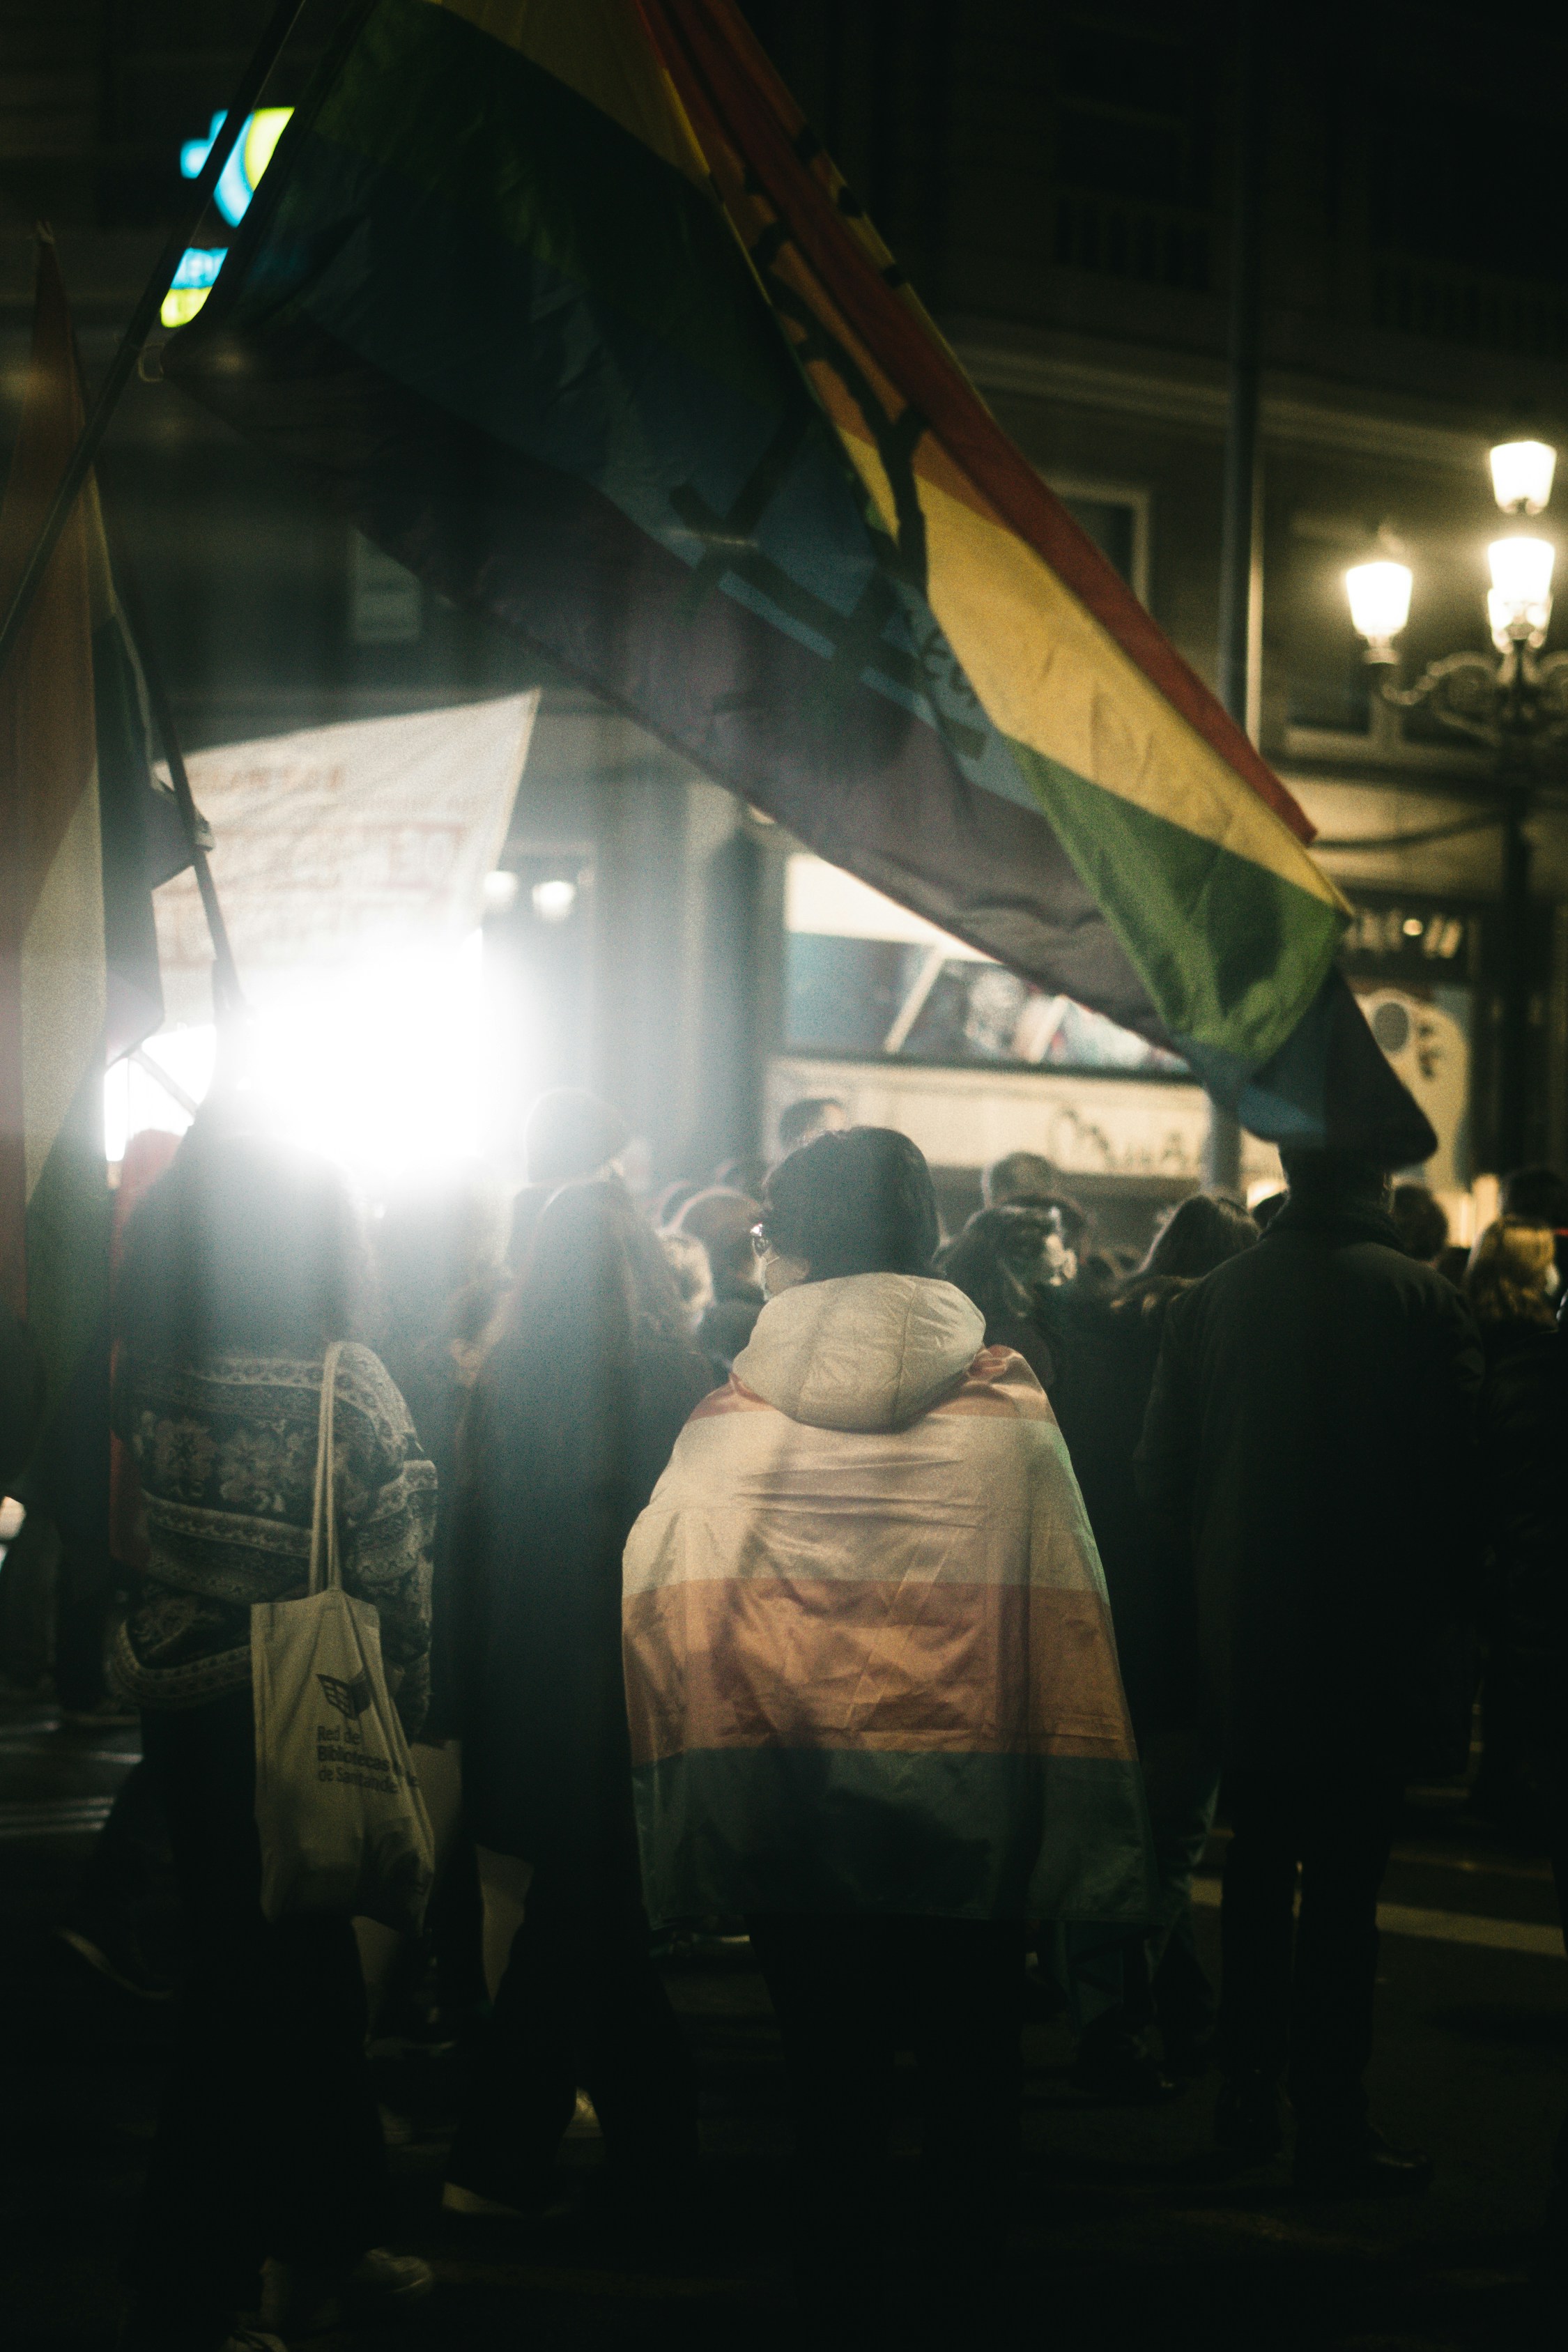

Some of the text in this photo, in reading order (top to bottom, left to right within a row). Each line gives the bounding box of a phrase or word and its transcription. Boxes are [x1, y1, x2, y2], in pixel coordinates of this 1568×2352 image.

[317, 1725, 361, 1745] Red de
[317, 1745, 390, 1772] Bibliotecas
[318, 1766, 333, 1782] de
[336, 1766, 399, 1794] Santande
